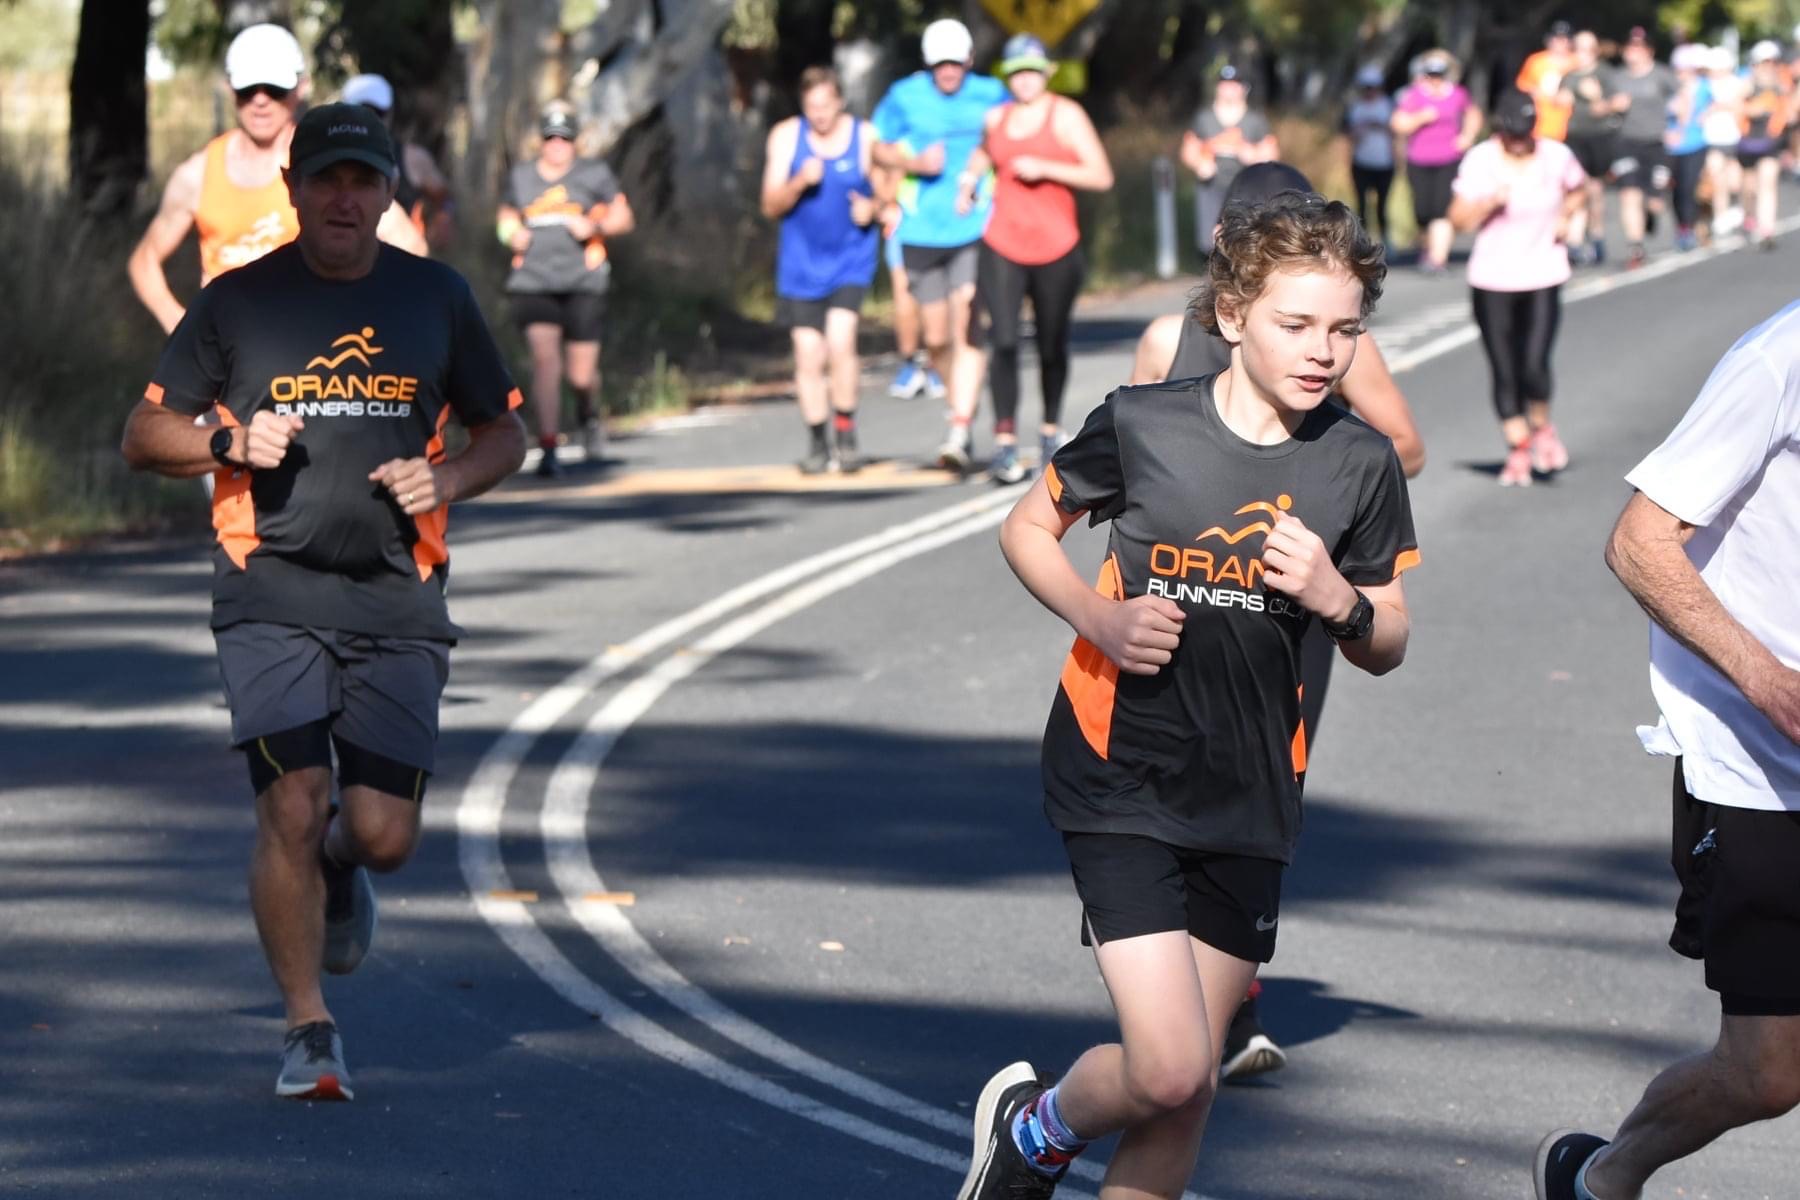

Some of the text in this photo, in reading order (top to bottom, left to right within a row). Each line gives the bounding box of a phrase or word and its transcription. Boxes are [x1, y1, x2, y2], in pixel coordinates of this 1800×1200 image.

[271, 375, 418, 401] ORANGE
[275, 401, 411, 417] RUNNERS CLUB
[1151, 543, 1265, 589] ORAN
[1147, 578, 1265, 612] RUNNERS
